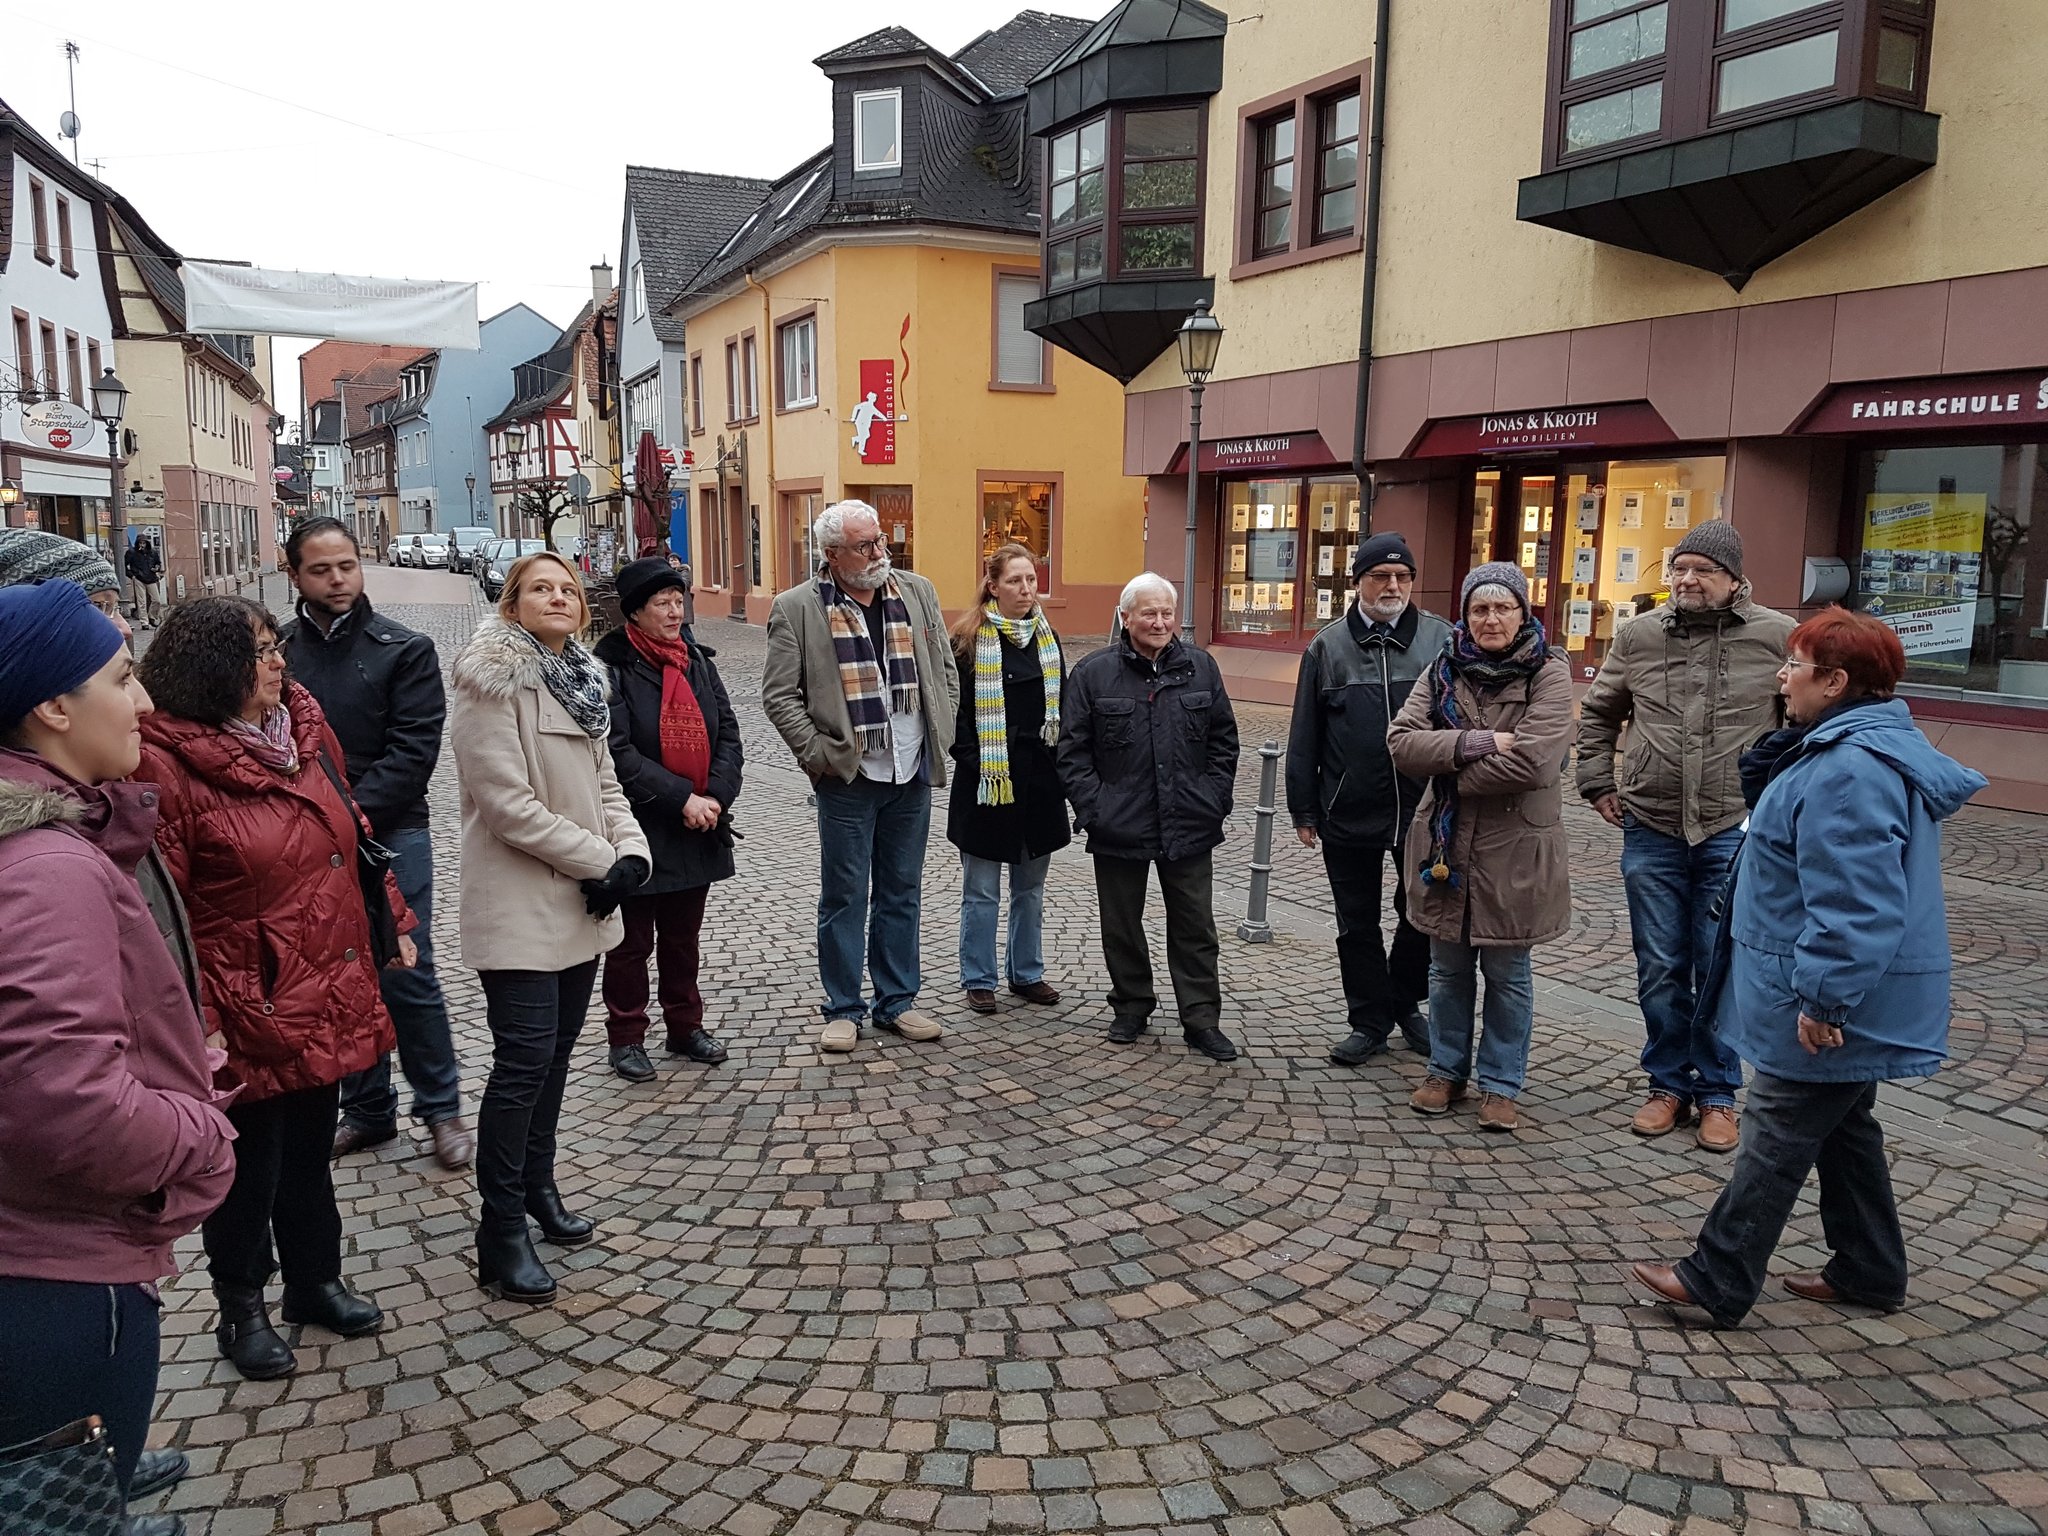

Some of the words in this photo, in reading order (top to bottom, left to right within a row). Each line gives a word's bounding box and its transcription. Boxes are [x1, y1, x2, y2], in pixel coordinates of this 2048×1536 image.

[884, 371, 894, 451] Brotmacher
[1852, 393, 2020, 418] FAHRSCHULE
[45, 412, 72, 420] Bistro
[29, 418, 89, 429] Stopschild
[1480, 416, 1524, 436] JONAS
[1527, 414, 1539, 430] &
[1543, 411, 1598, 429] KROTH
[50, 434, 70, 442] STOP
[1496, 432, 1576, 445] IMMOBILIEN
[1215, 442, 1243, 458] JONAS
[1244, 440, 1253, 453] &
[1254, 438, 1290, 452] KROTH
[1226, 454, 1277, 464] IMMOBILIEN
[1911, 606, 1962, 619] FAHRSCHULE
[1892, 623, 1933, 635] lmann
[1919, 637, 1963, 648] Führerschein!
